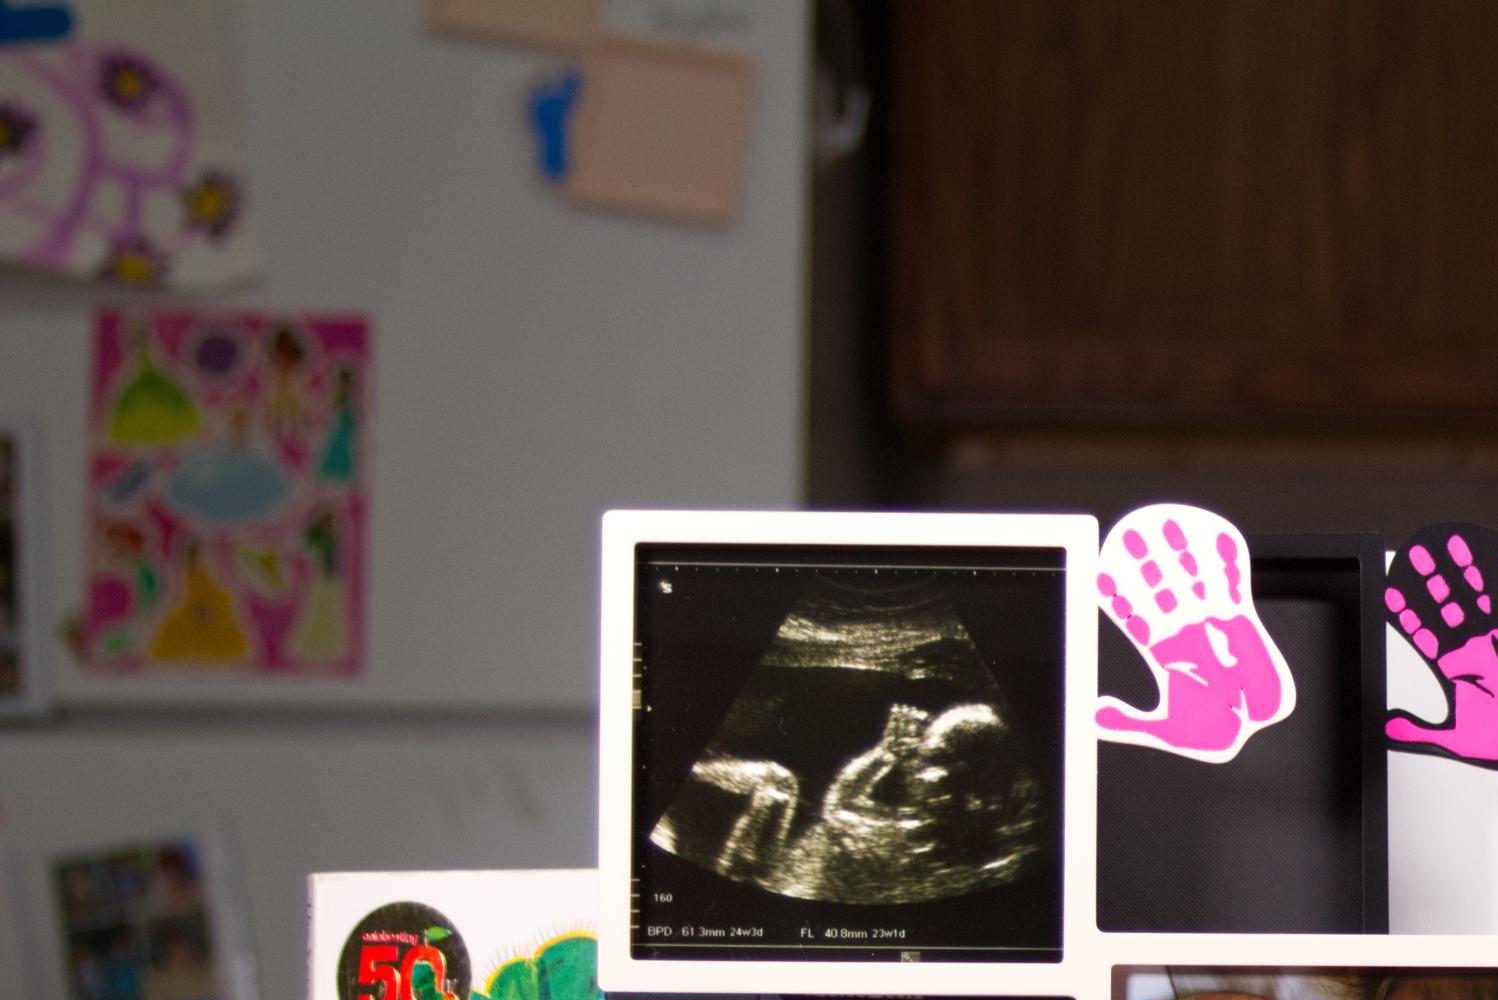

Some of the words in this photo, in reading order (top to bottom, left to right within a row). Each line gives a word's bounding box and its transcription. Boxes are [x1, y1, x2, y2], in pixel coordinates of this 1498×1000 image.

[654, 893, 673, 903] 160
[647, 926, 673, 937] BPD
[730, 927, 763, 937] 24w3d
[800, 927, 814, 938] FL
[872, 929, 906, 938] 23w1d
